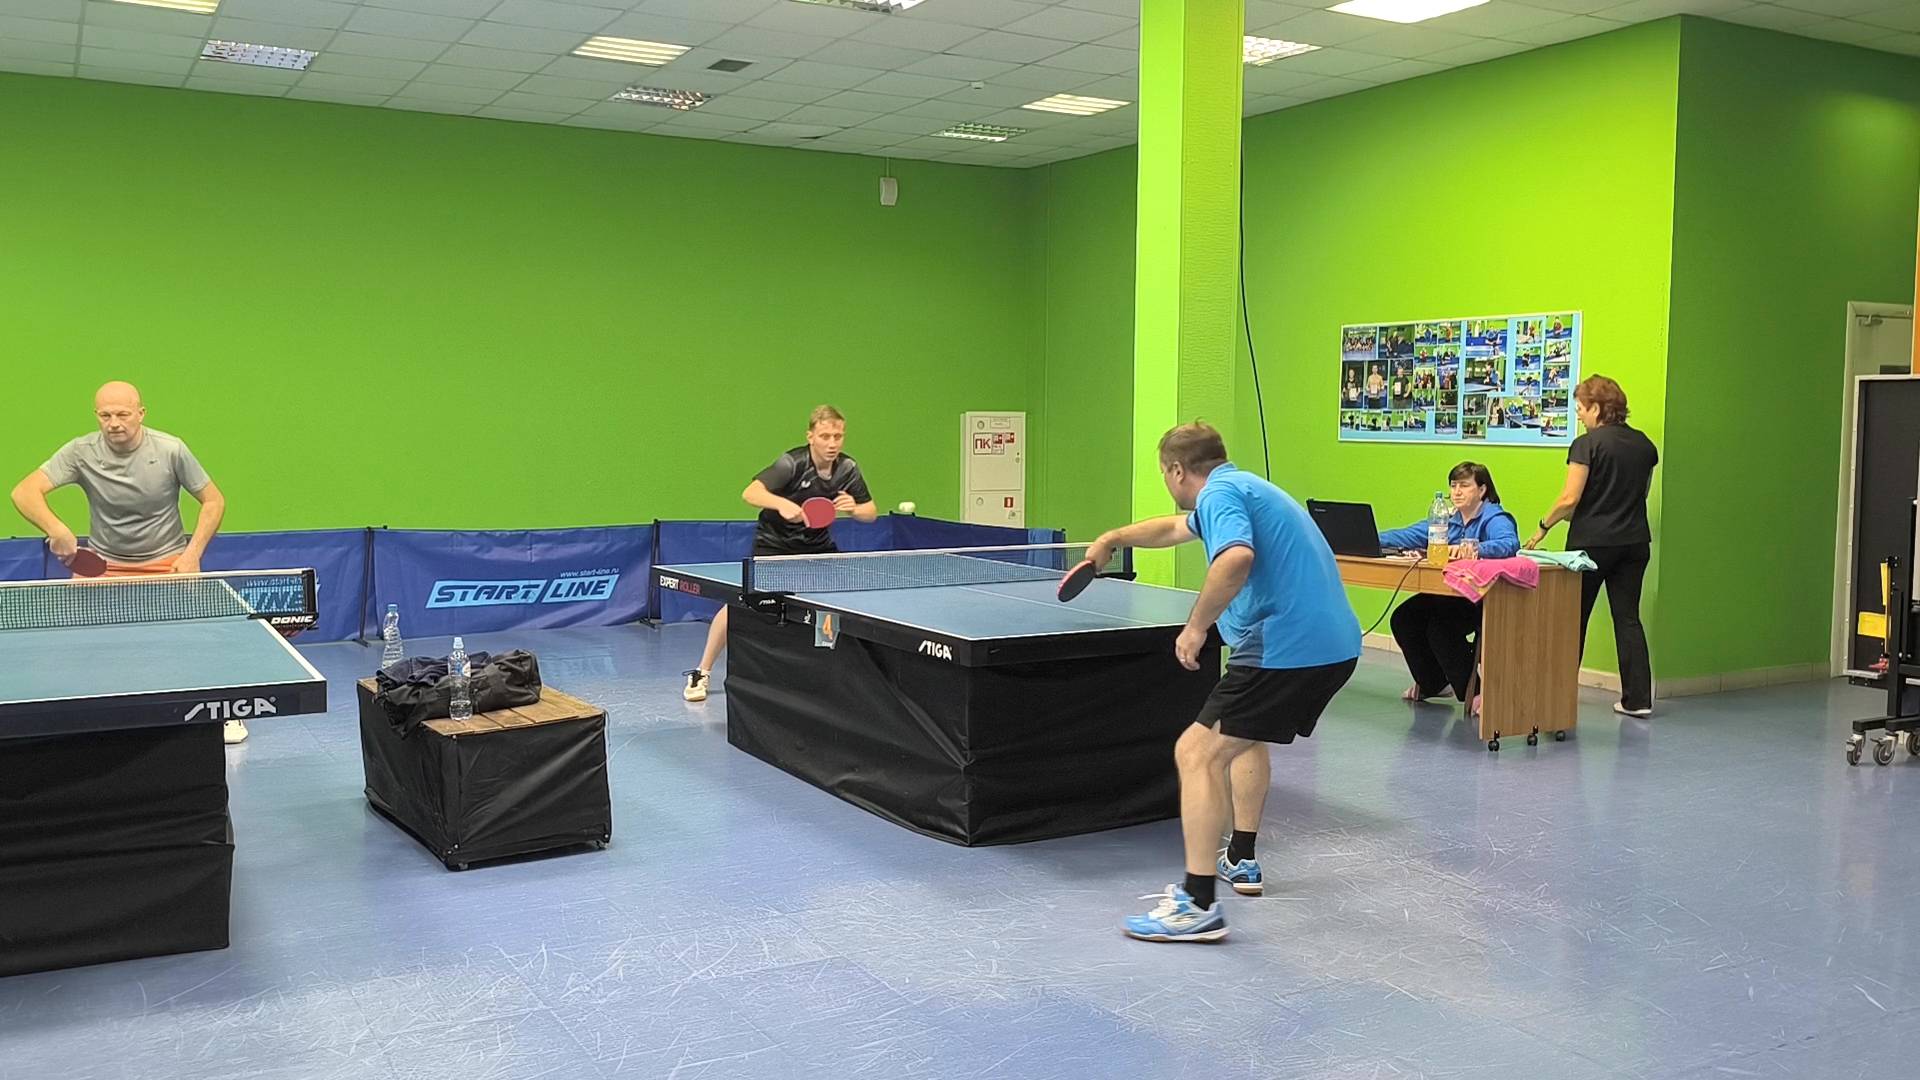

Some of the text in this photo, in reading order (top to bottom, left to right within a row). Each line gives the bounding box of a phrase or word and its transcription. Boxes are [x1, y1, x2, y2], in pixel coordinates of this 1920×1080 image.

[975, 438, 991, 449] ПК
[434, 580, 610, 603] START LINE
[271, 615, 314, 625] DONIC
[822, 614, 834, 640] 4
[918, 639, 952, 661] STIGA
[184, 697, 277, 722] STIGA
